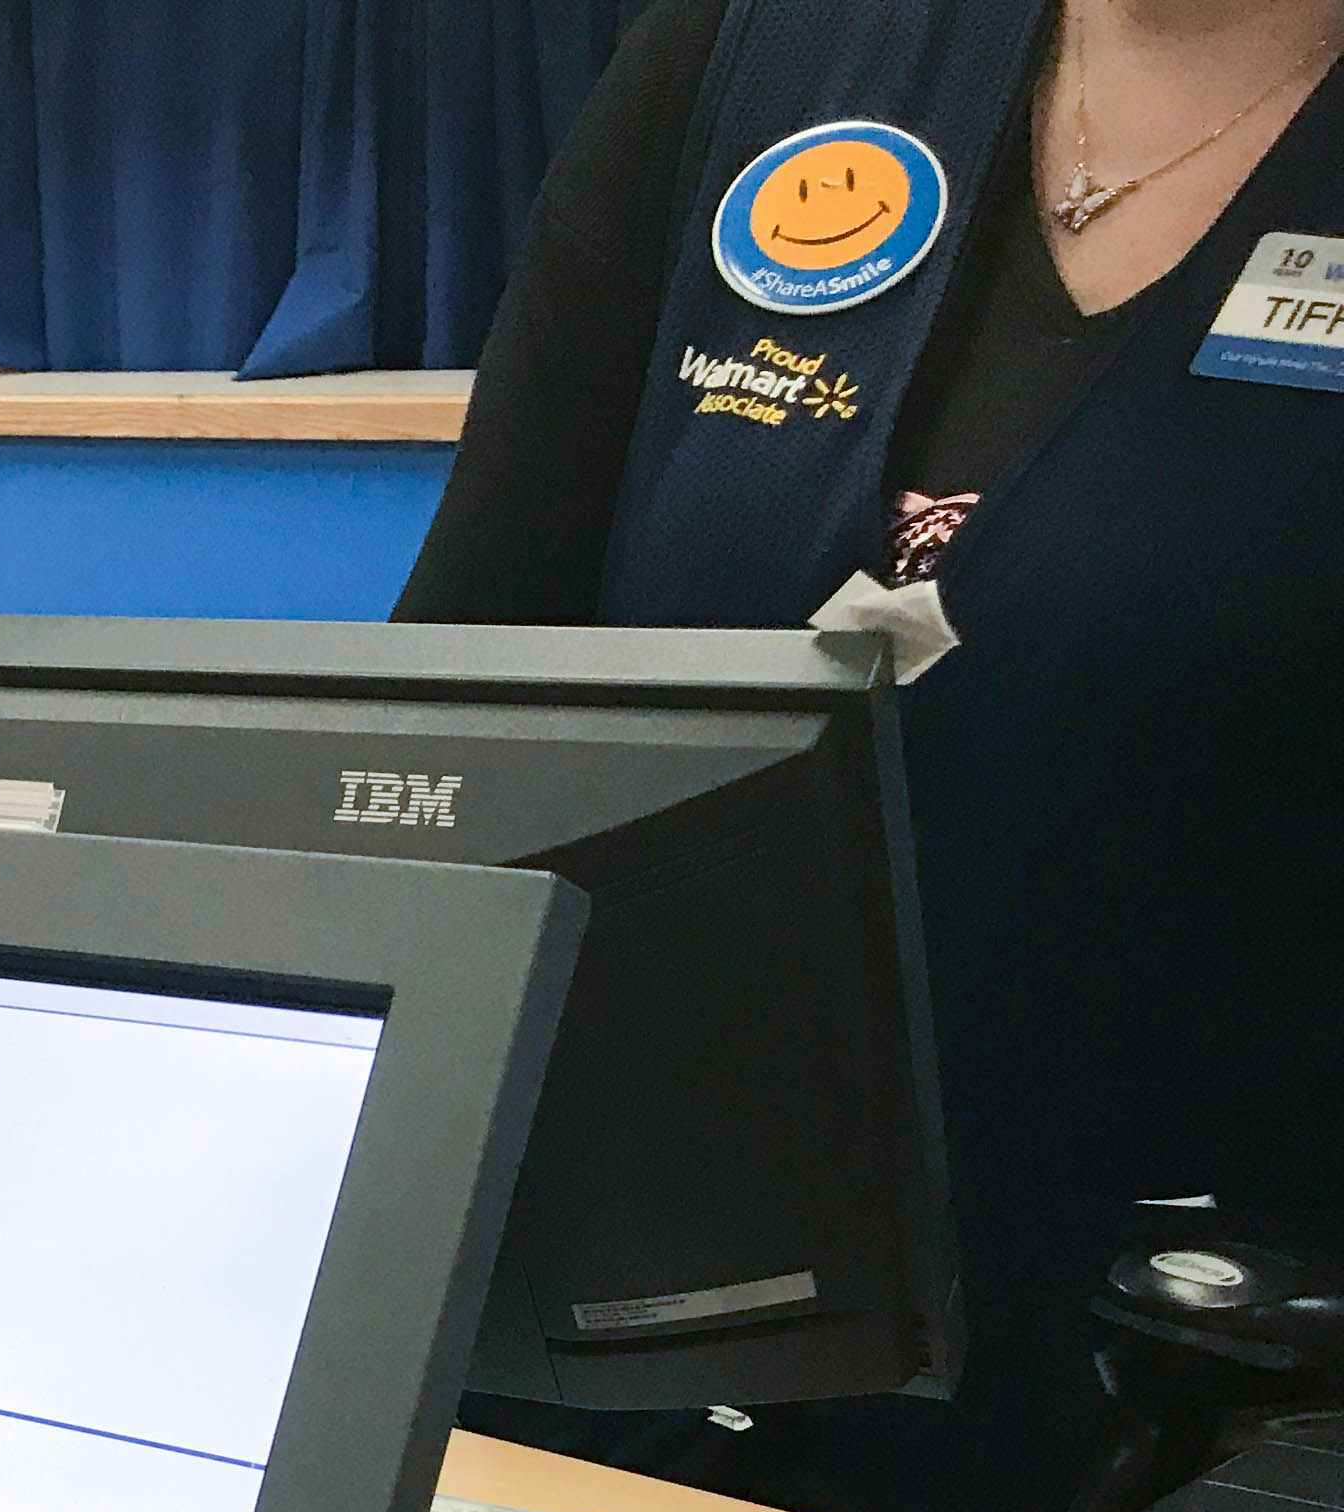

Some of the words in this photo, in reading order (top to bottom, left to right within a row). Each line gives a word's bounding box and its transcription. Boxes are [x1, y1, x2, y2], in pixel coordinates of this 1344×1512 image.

[751, 257, 893, 298] #ShareASmile
[1280, 248, 1314, 269] 10
[678, 345, 807, 403] Walmart
[750, 338, 826, 376] Proud
[332, 769, 463, 828] IBM
